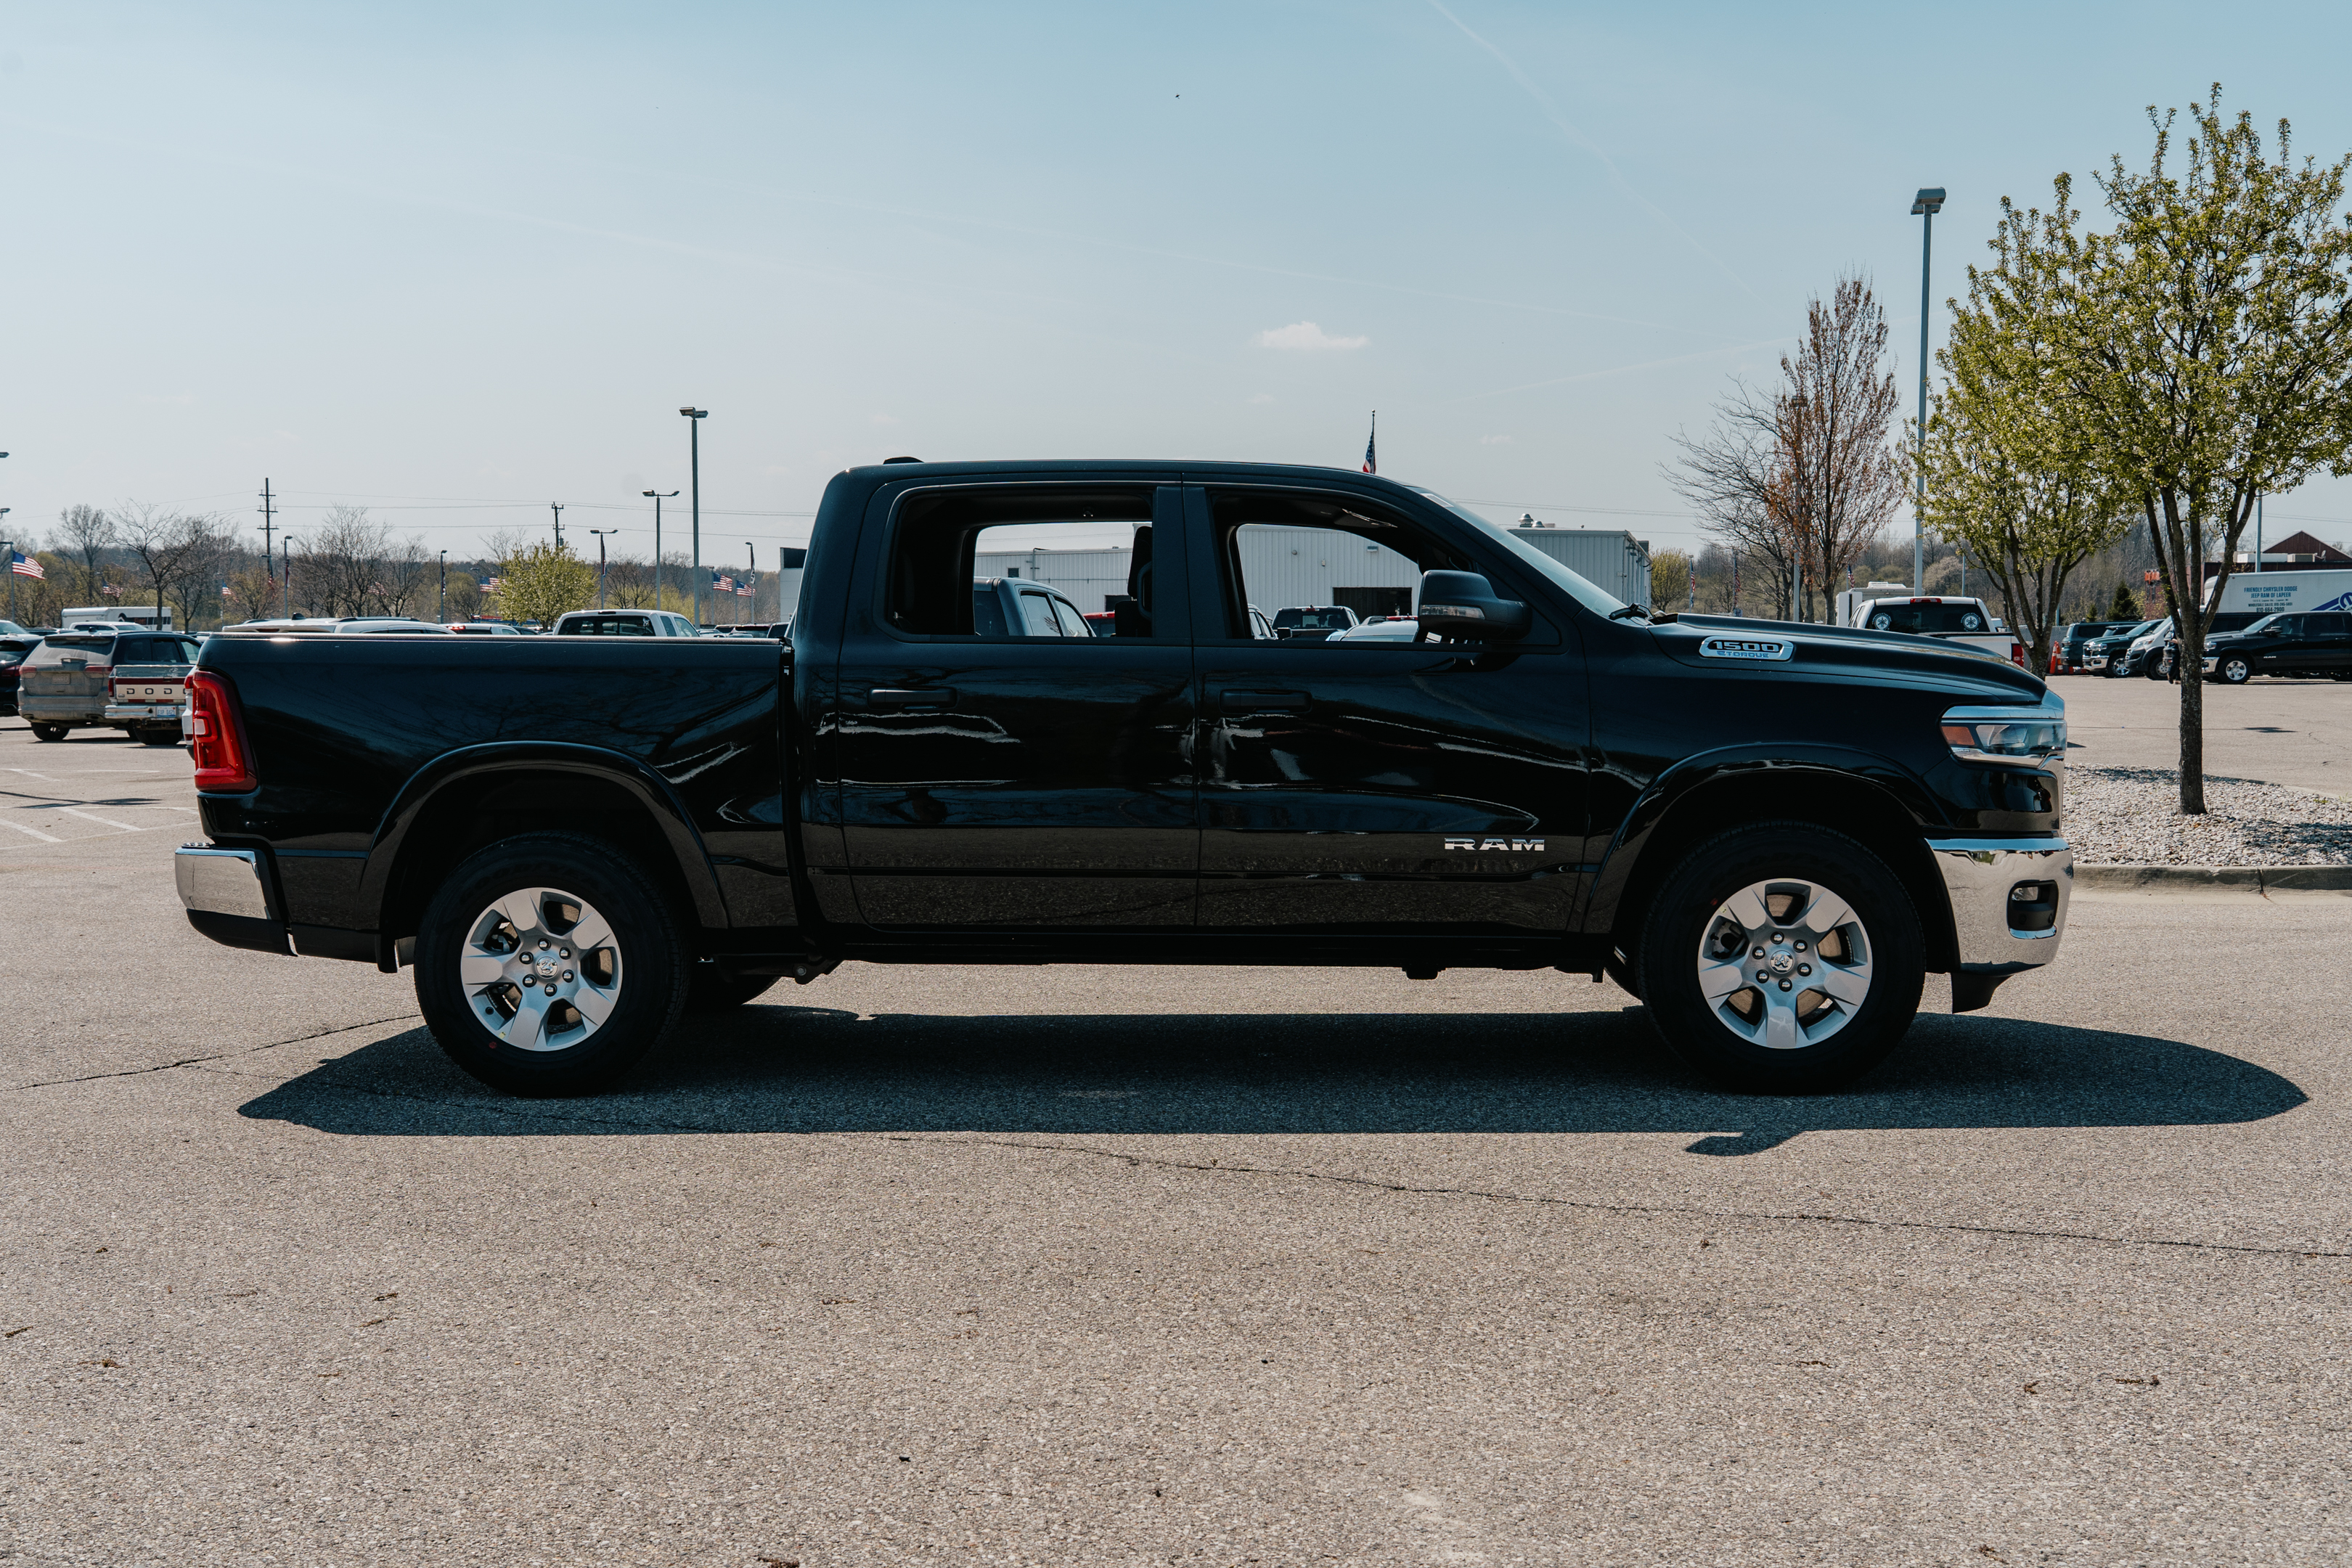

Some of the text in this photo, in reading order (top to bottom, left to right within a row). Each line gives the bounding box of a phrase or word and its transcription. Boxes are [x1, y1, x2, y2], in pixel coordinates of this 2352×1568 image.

[1713, 641, 1779, 652] 1500
[1444, 838, 1545, 851] RAM
[456, 862, 620, 907] GOODYEAR
